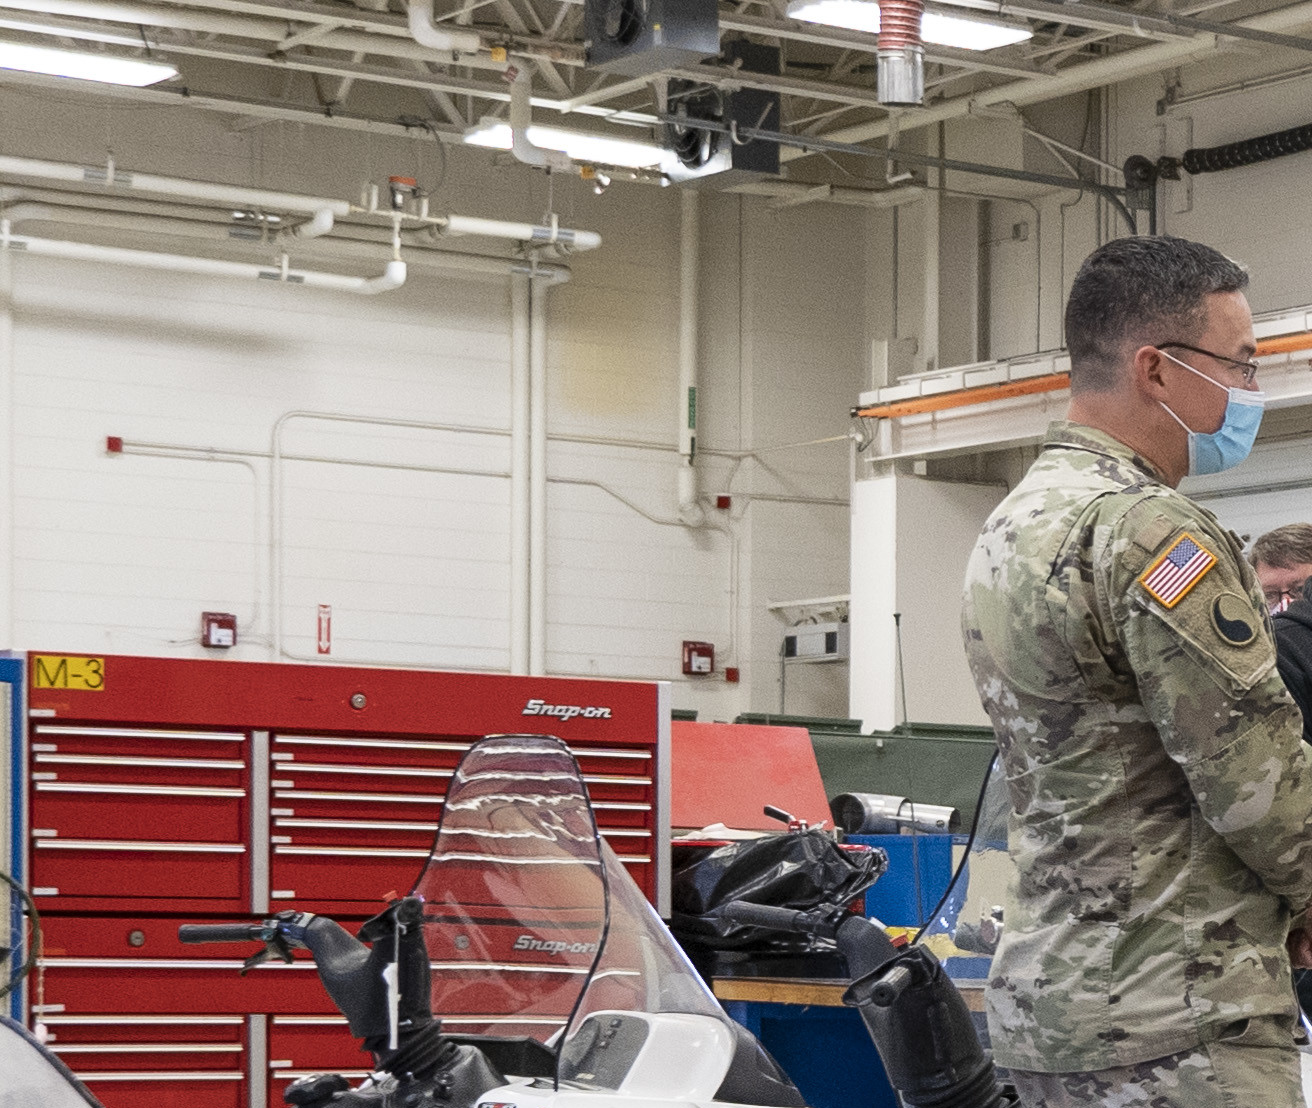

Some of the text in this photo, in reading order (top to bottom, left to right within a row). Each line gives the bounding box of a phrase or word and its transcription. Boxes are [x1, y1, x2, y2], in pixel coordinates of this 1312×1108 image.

[36, 657, 104, 689] M-3
[522, 699, 613, 721] Snap-on
[513, 934, 600, 956] Snap-on
